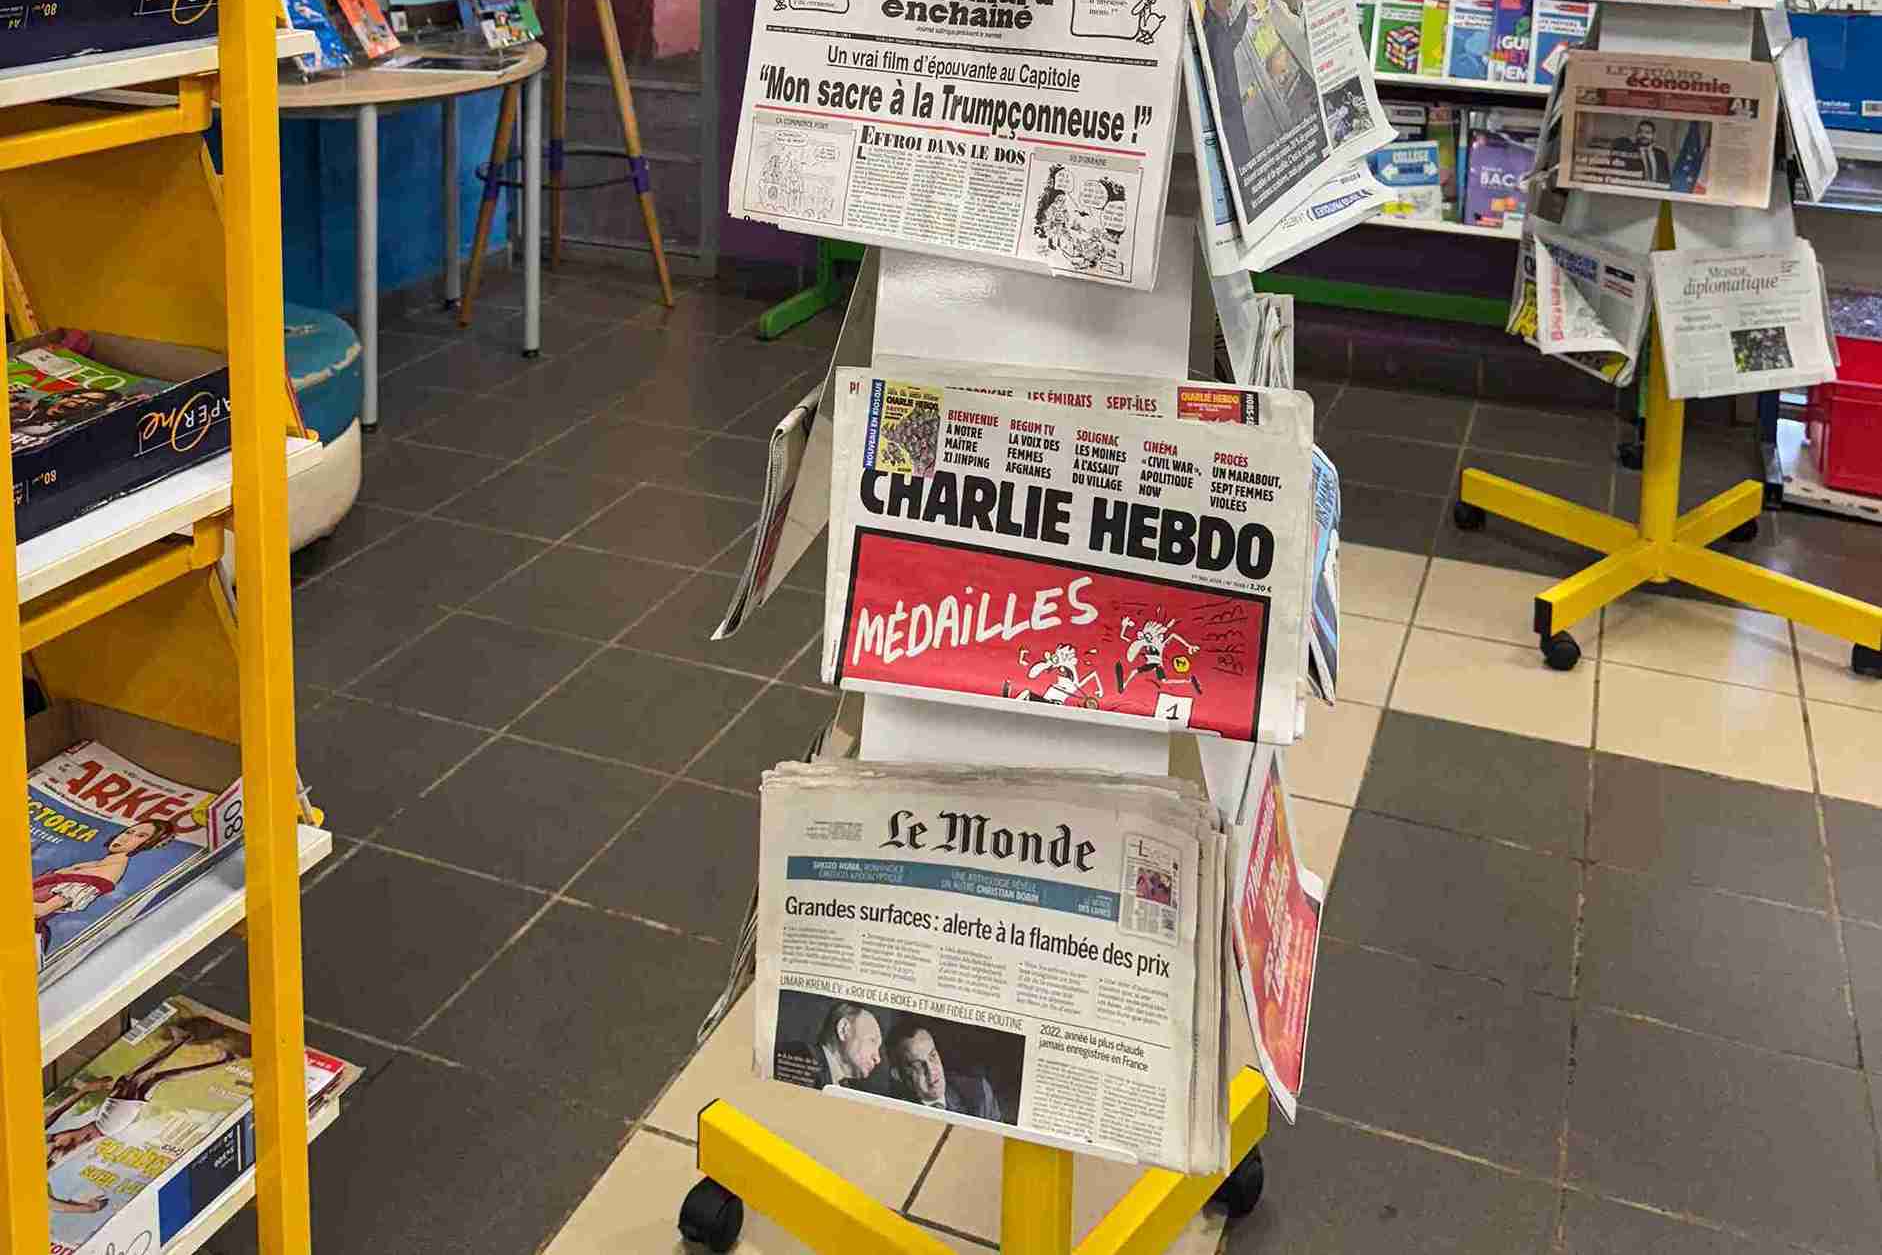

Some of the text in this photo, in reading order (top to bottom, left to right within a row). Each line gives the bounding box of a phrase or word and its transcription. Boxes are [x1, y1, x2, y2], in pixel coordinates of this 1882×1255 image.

[828, 45, 848, 63] Un
[852, 49, 878, 68] vrai
[883, 50, 908, 72] film
[913, 55, 997, 81] d'épouvante
[1000, 66, 1015, 83] au
[1019, 63, 1080, 90] Capitole
[1626, 72, 1731, 94] économie
[817, 78, 882, 113] sacre
[889, 78, 904, 116] à
[912, 82, 934, 120] la
[942, 84, 1125, 142] Trumpçonneuse
[928, 138, 967, 157] DANS
[970, 145, 989, 161] LE
[994, 147, 1026, 165] DOS
[1683, 275, 1779, 299] diplomatique
[947, 409, 999, 427] BIENVENUE
[1010, 419, 1055, 436] BEGUM TV
[954, 426, 983, 439] NOTRE
[1077, 430, 1120, 446] SOLIGNAC
[1009, 433, 1060, 452] LA VOIX DES
[1143, 441, 1178, 456] CINÉMA
[954, 453, 990, 469] JINPING
[1007, 447, 1043, 463] FEMMES
[1075, 443, 1127, 463] LES MOINES
[1214, 452, 1248, 467] PROCÈS
[1005, 461, 1051, 479] AFGHANES
[1081, 459, 1119, 477] L'ASSAUT
[1072, 473, 1123, 492] DU VILLAGE
[1140, 470, 1193, 489] APOLITIQUE
[1212, 466, 1282, 490] UN MARABOUT,
[1139, 484, 1161, 498] NOW
[1210, 482, 1274, 502] SEPT FEMMES
[1210, 495, 1248, 513] VIOLÉES
[859, 468, 1275, 579] CHARLIE HEBDO
[1163, 702, 1180, 721] 1
[880, 809, 928, 850] Le
[931, 810, 1097, 874] Monde
[785, 895, 856, 920] Grandes
[943, 913, 992, 941] alerte
[996, 920, 1006, 943] à
[1011, 923, 1025, 947] la
[1029, 926, 1098, 961] flambée
[1102, 942, 1133, 969] des
[1137, 953, 1171, 978] prix
[780, 973, 1023, 1031] UMAR DE LA AMI FIDÈLE DE POUTINE
[1064, 1029, 1089, 1046] année
[1098, 1035, 1114, 1053] plus
[1115, 1040, 1144, 1059] chaude
[1038, 1037, 1065, 1053] jamais
[1122, 1055, 1149, 1073] France
